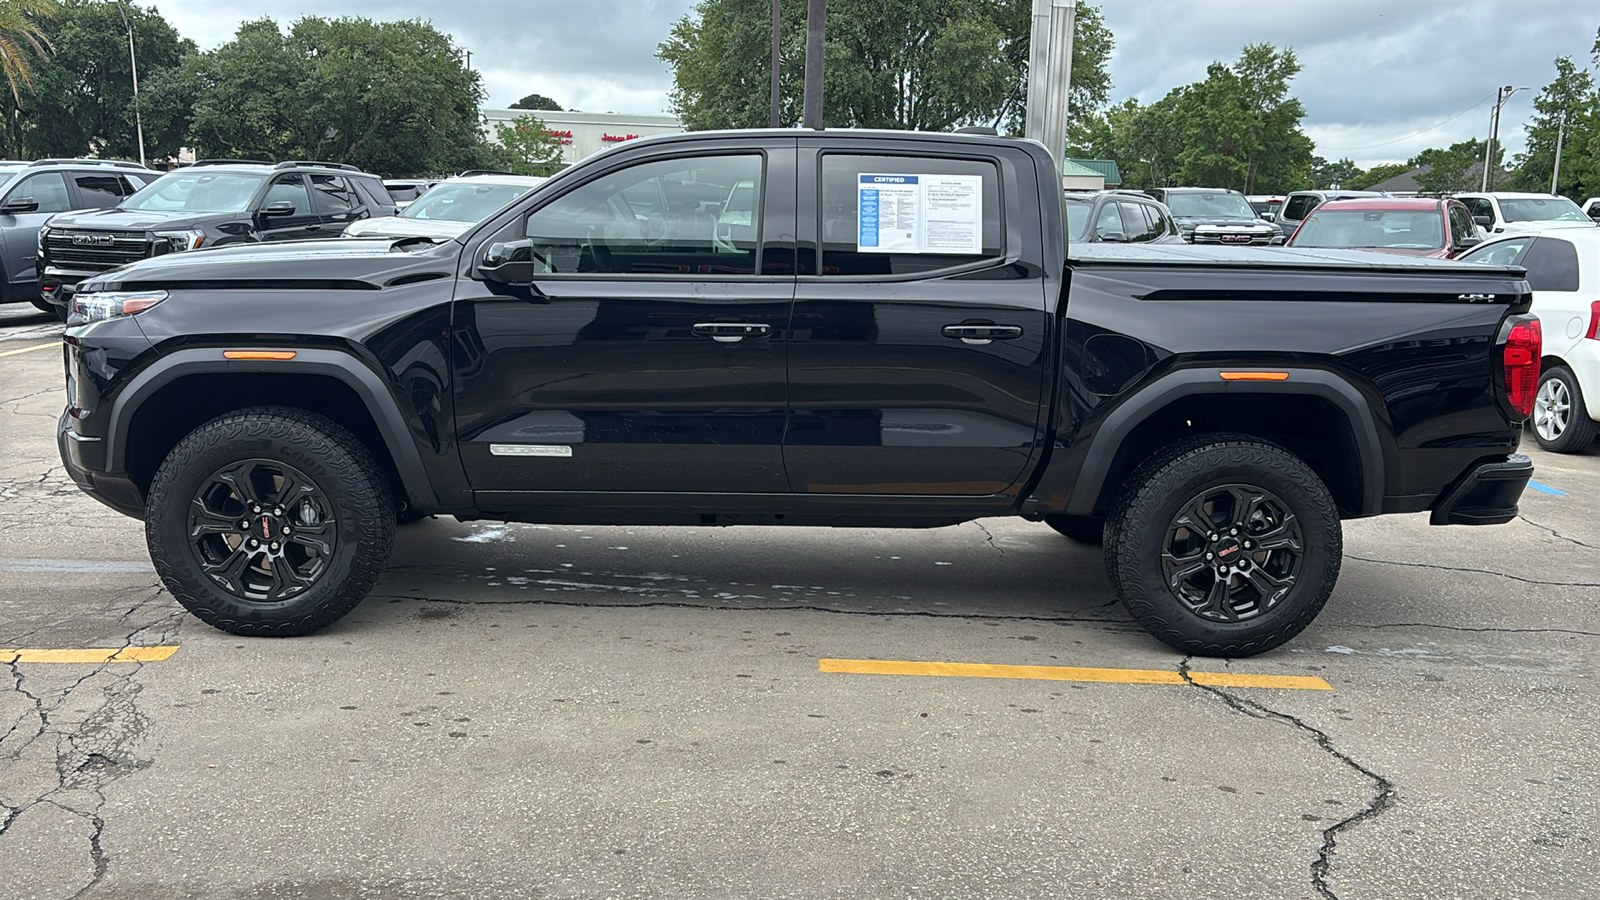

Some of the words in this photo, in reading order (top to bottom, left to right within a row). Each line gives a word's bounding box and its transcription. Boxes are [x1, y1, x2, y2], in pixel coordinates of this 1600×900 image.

[73, 235, 114, 246] GMC
[495, 446, 567, 455] ELEVATION
[261, 516, 270, 539] GMC
[1218, 544, 1239, 558] GMC
